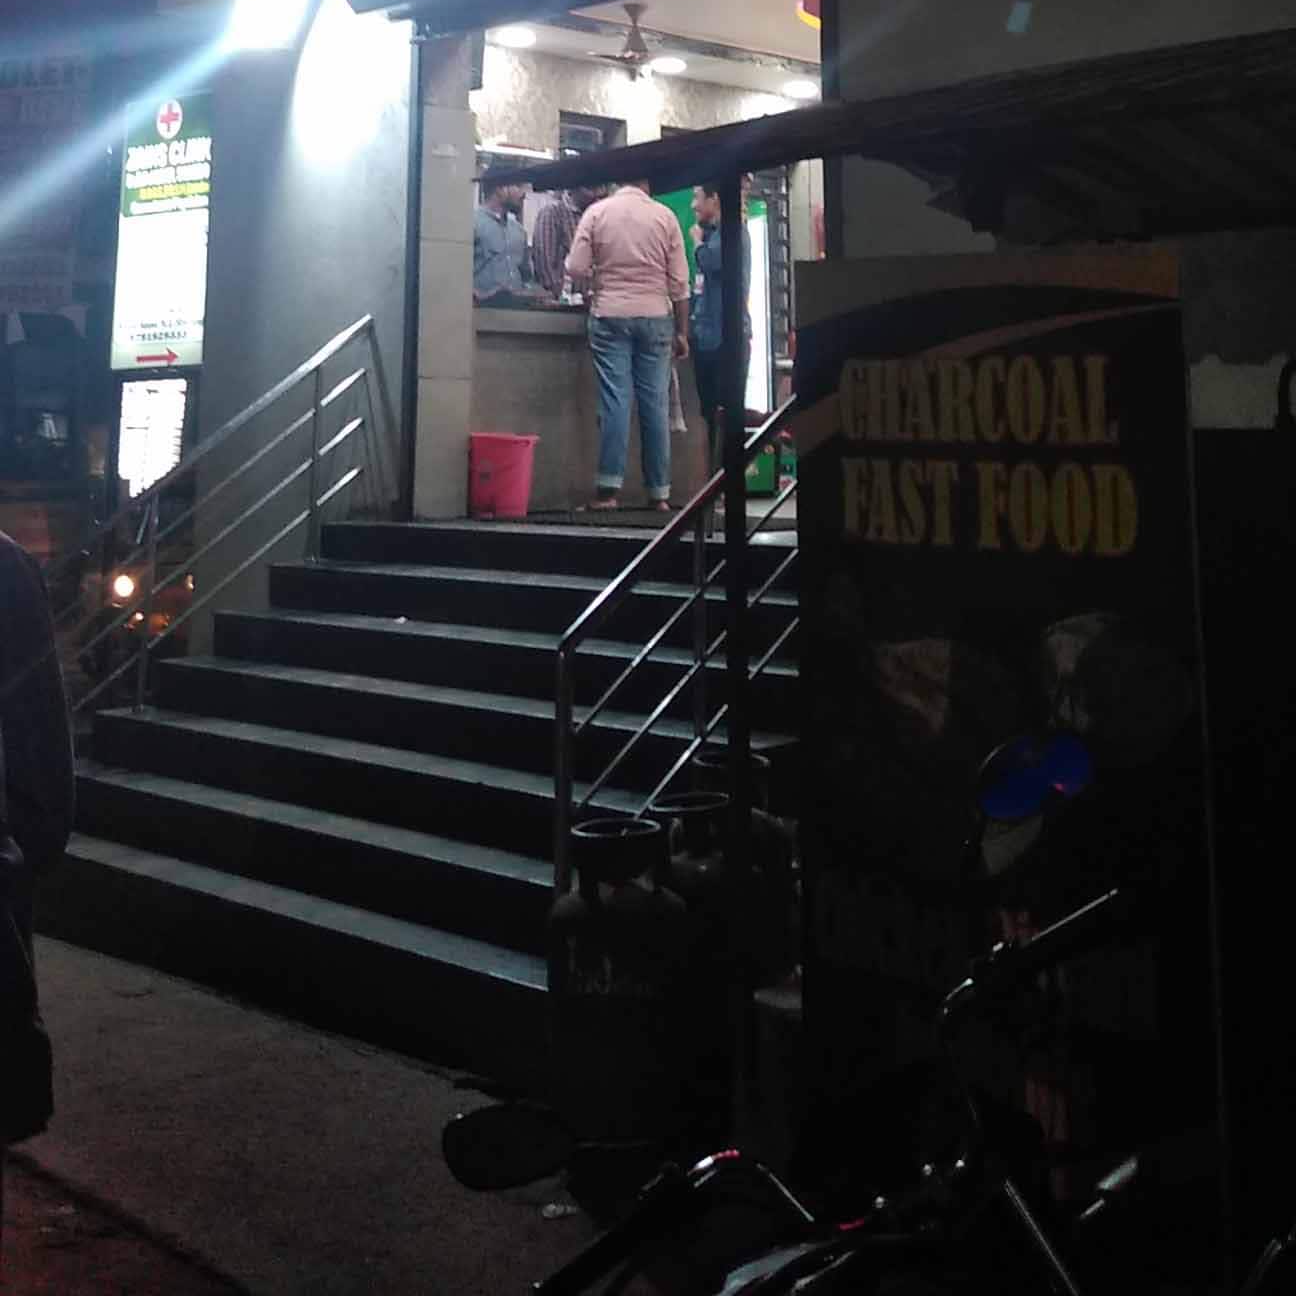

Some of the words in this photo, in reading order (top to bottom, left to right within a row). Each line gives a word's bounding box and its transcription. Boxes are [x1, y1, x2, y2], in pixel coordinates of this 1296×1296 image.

[838, 353, 1120, 447] CHARCOAL
[841, 456, 959, 547] FAST
[975, 458, 1140, 558] FOOD
